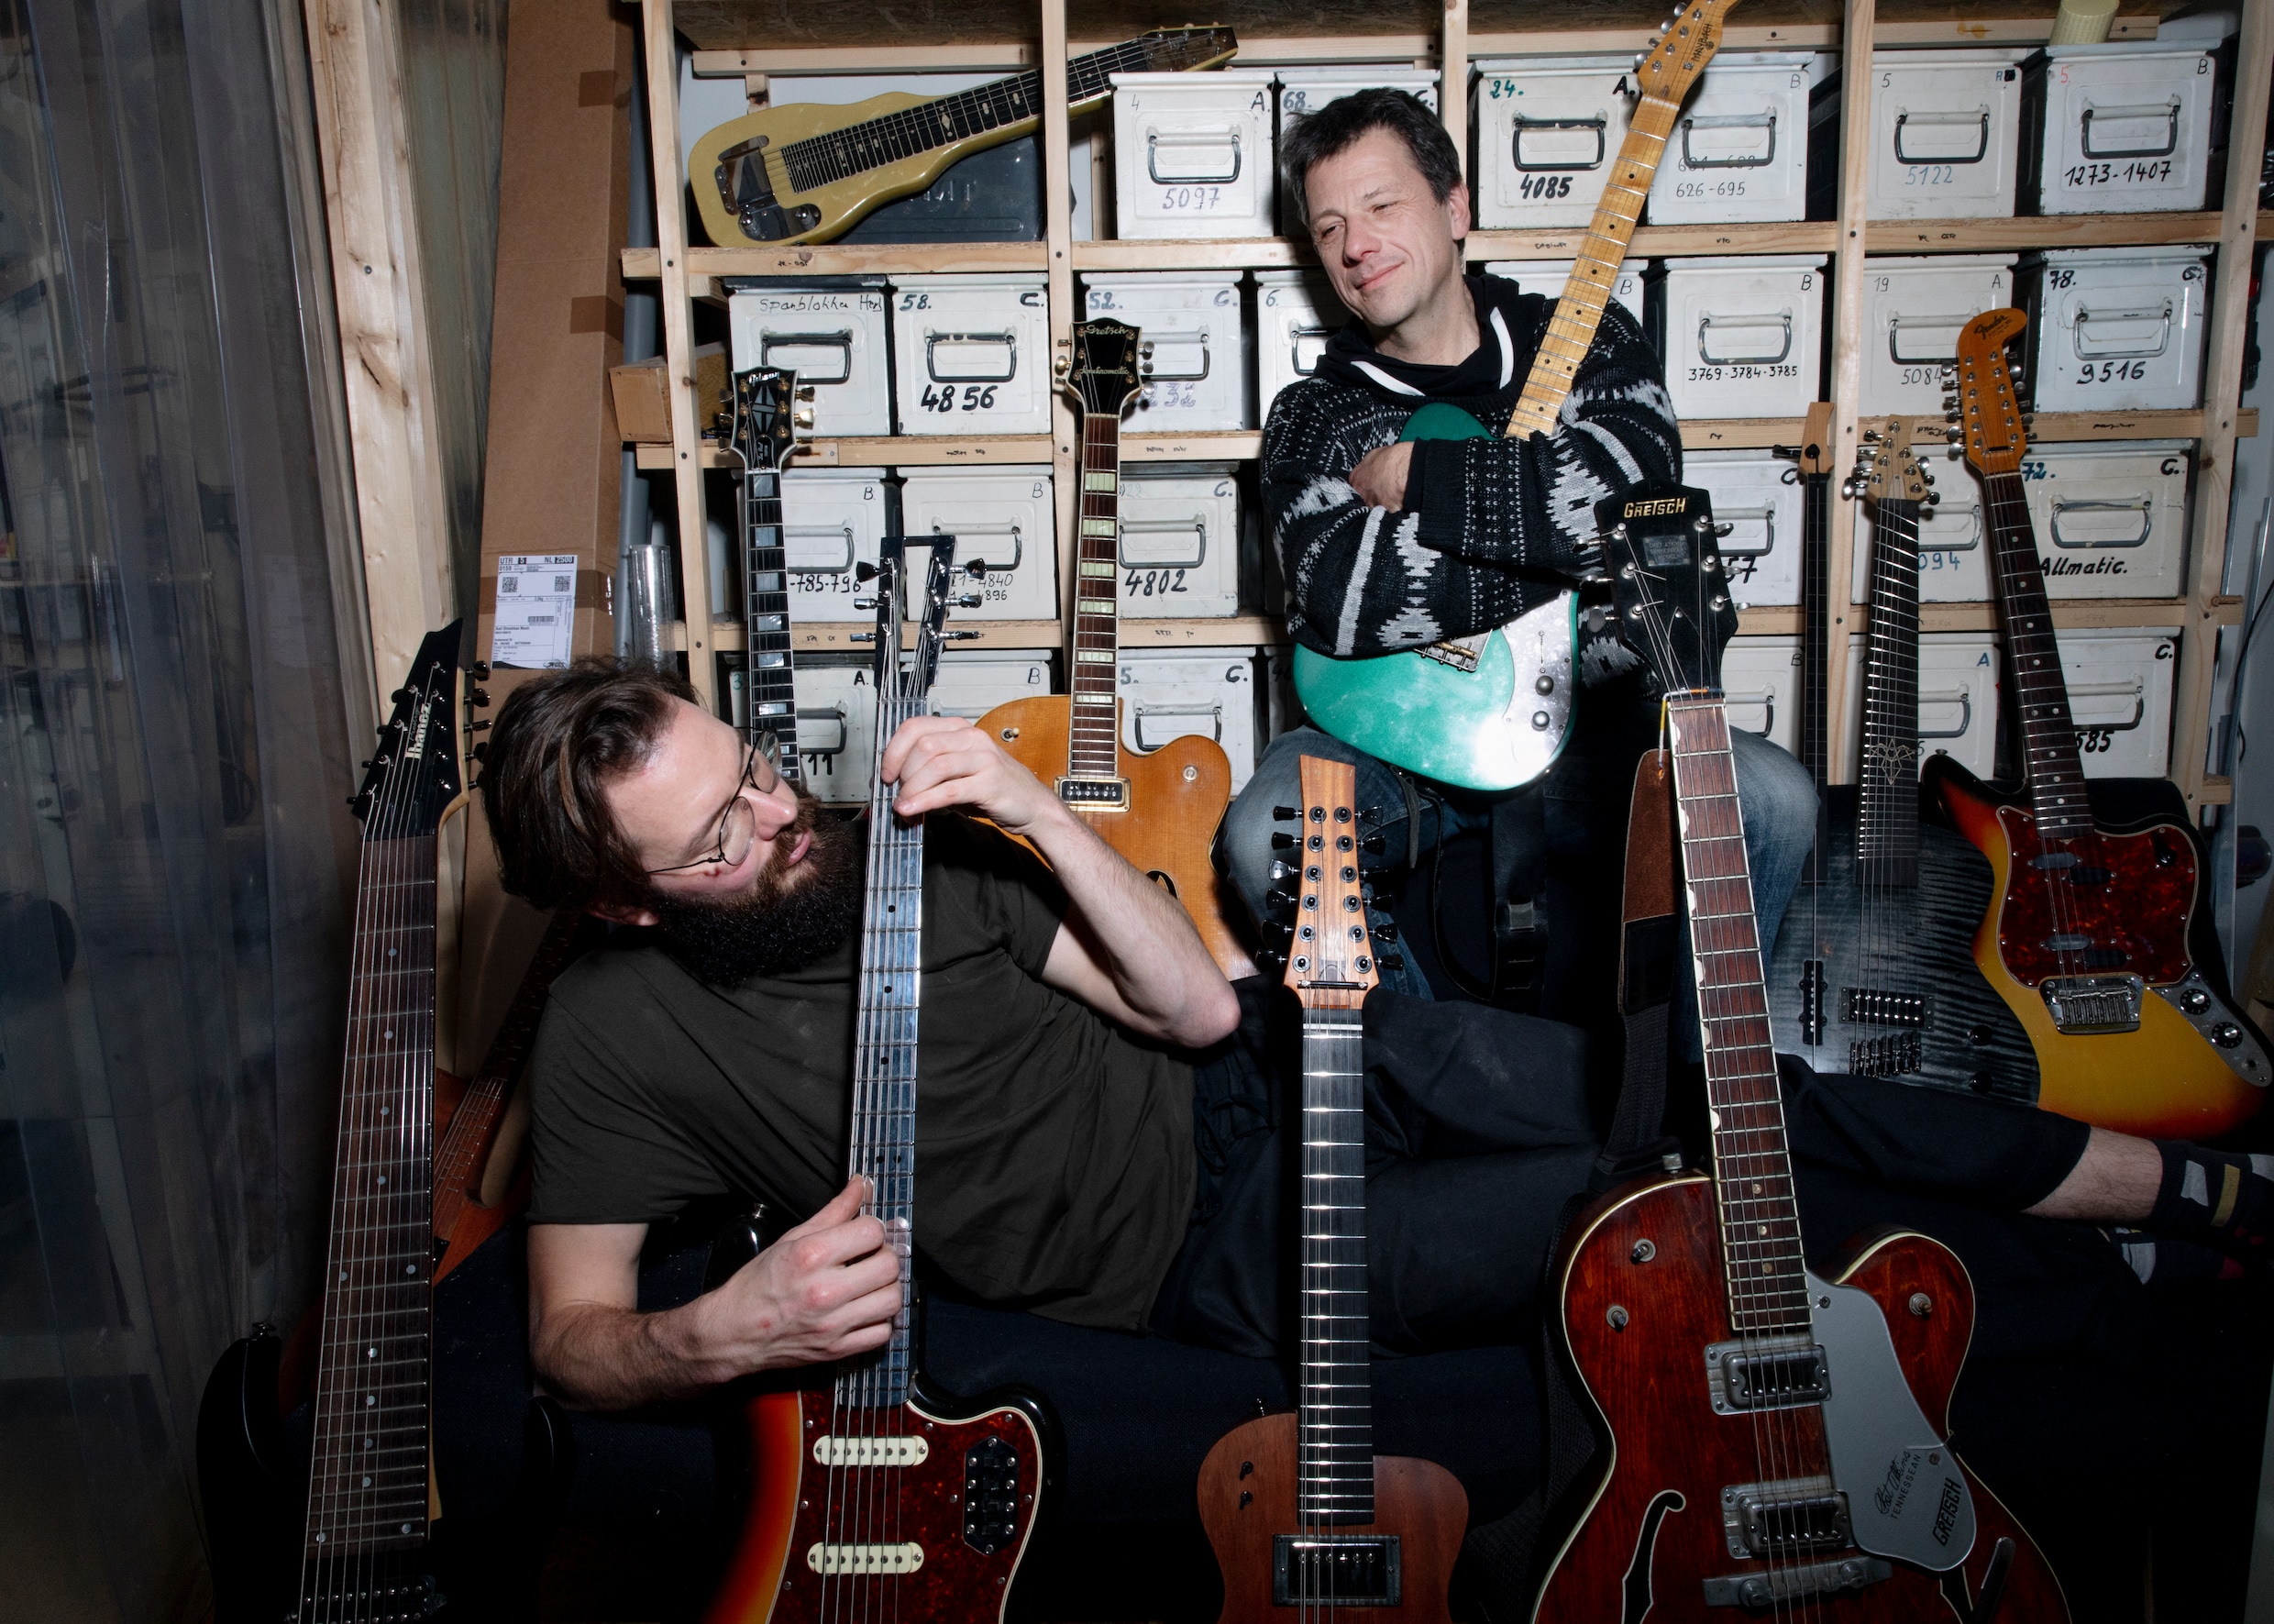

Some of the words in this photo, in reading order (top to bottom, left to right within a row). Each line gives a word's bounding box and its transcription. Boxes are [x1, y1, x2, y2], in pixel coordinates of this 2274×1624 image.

[1691, 23, 1713, 61] MAYBACH
[1488, 79, 1524, 98] 24.
[1612, 74, 1636, 95] A.
[1882, 72, 1891, 88] 5
[1283, 91, 1312, 111] 68.
[1904, 165, 1954, 185] 5122
[2064, 160, 2172, 186] 1273-1407
[1519, 175, 1574, 200] 4085
[1161, 187, 1220, 211] 5097
[1619, 279, 1633, 295] B
[1874, 277, 1890, 292] 19
[2048, 270, 2077, 289] 78.
[898, 293, 933, 311] 58.
[1085, 324, 1129, 335] Gretsch
[1973, 315, 2008, 340] Fender
[749, 370, 780, 386] Gibson
[1901, 362, 1943, 385] 5084
[2075, 360, 2147, 384] 9516
[1032, 482, 1043, 499] B
[1623, 497, 1687, 519] GRETSCH
[2039, 557, 2128, 577] Allmatic.
[1125, 569, 1188, 597] 4802
[1791, 653, 1803, 666] B
[1976, 652, 1991, 667] A
[1028, 668, 1041, 685] B
[404, 702, 432, 759] Ibanez
[1891, 1453, 1922, 1520] TENNESSEAN
[1932, 1477, 1962, 1547] GRETSCH
